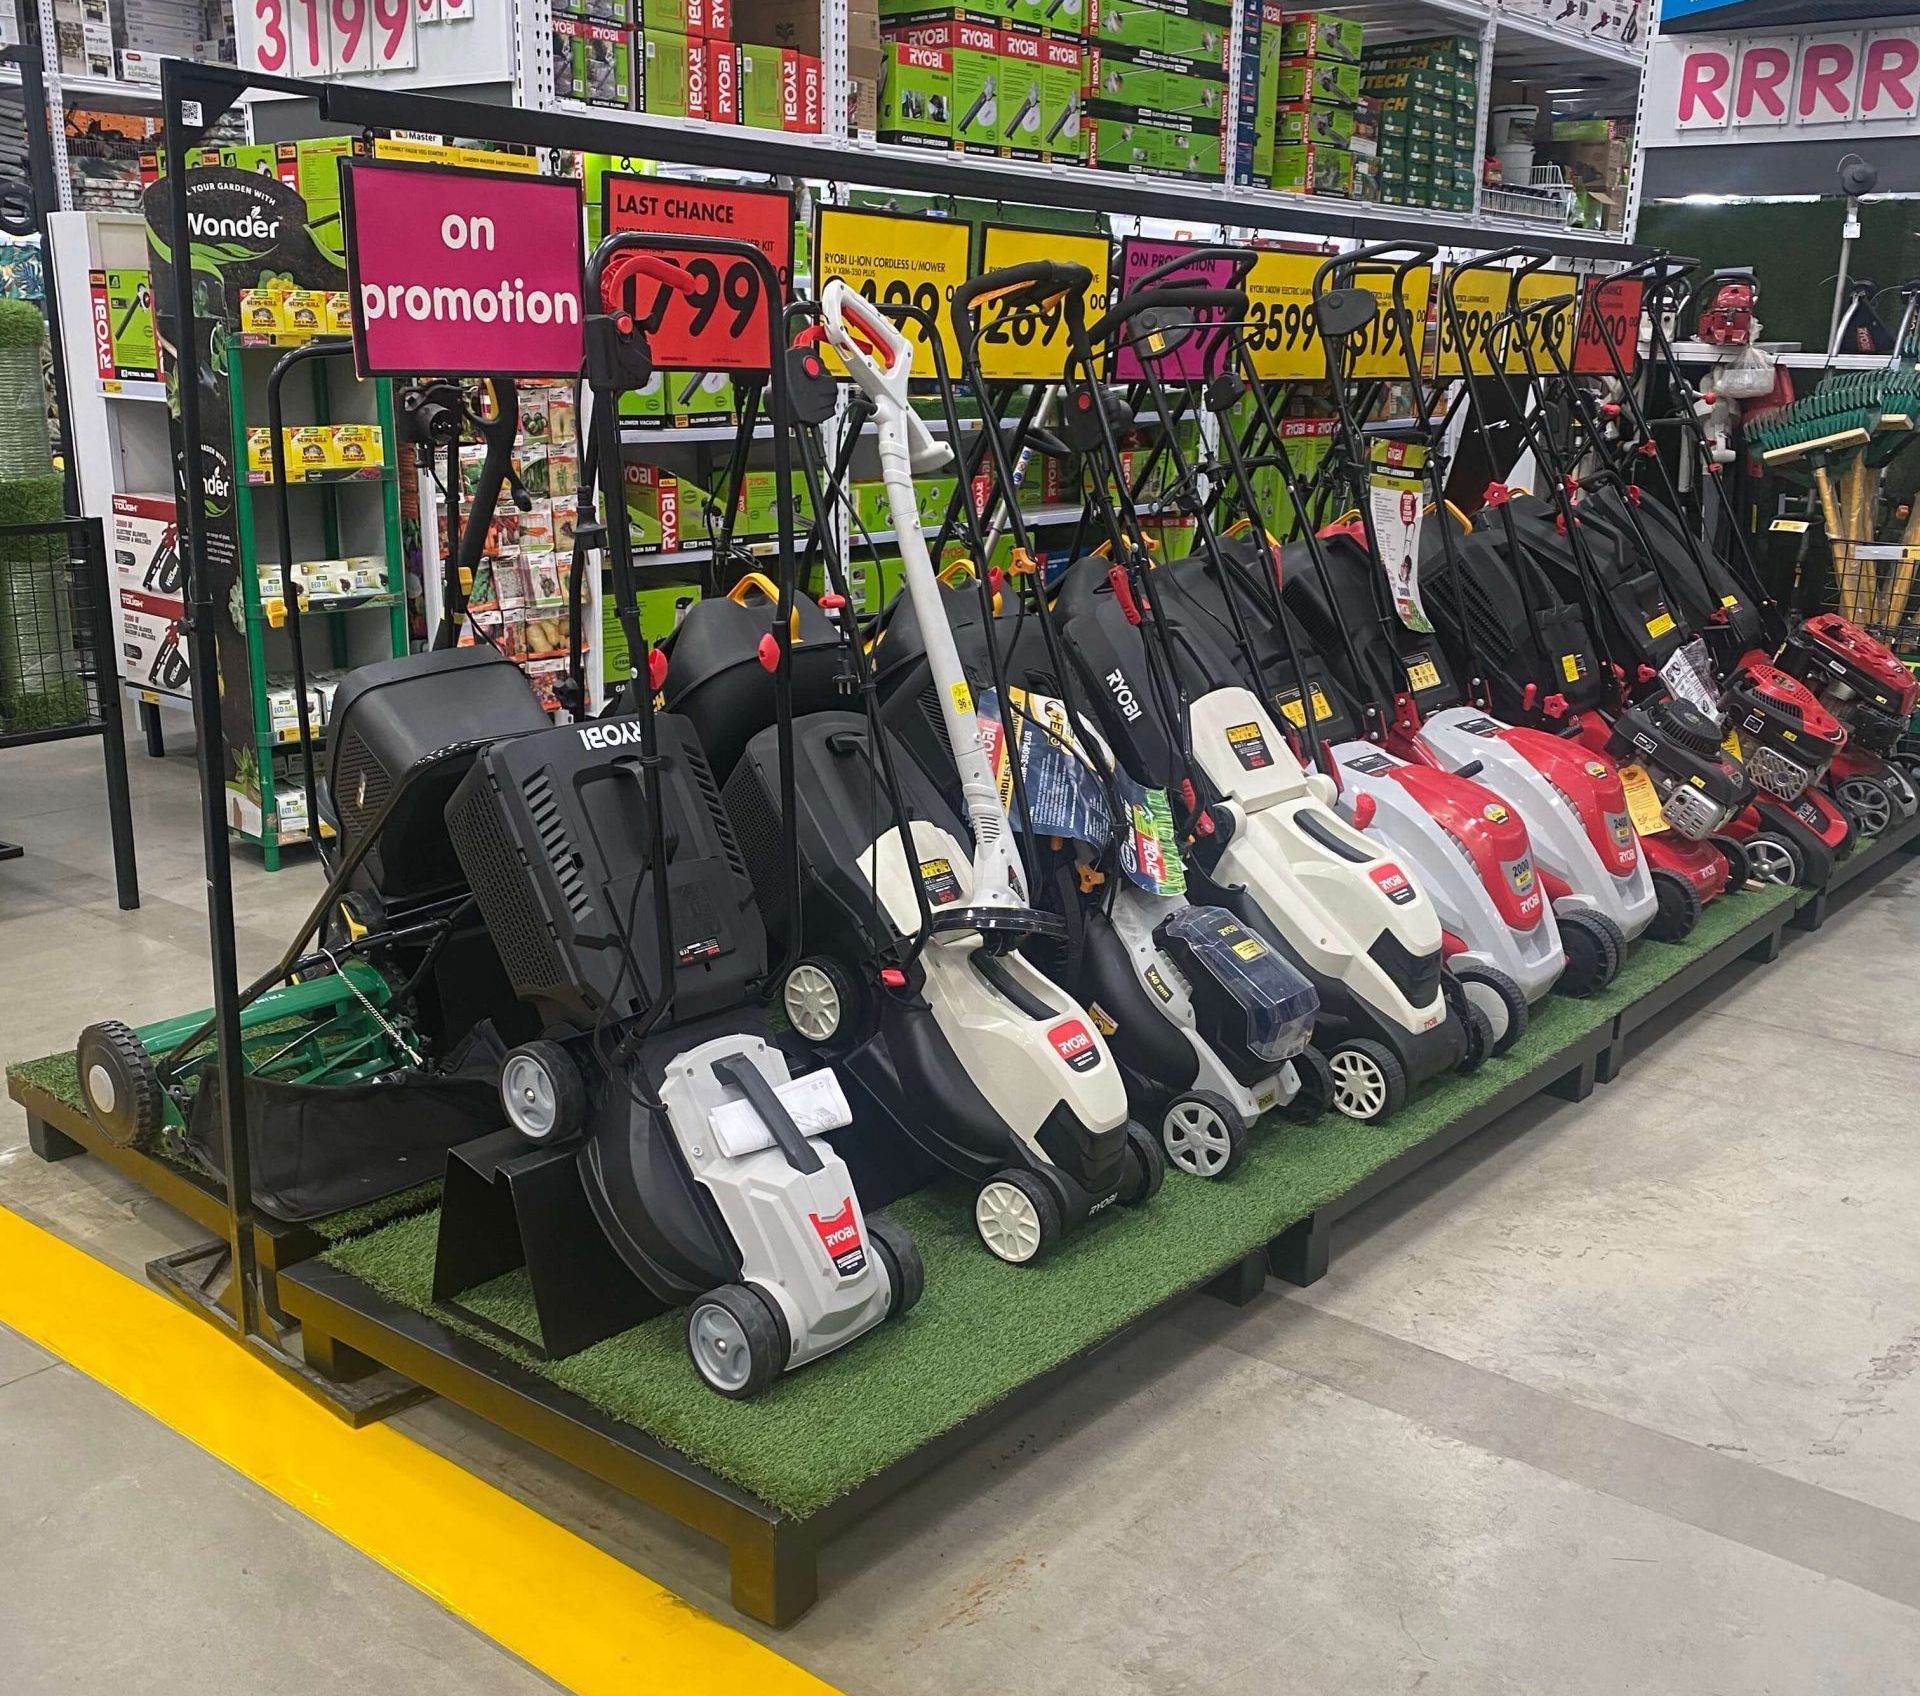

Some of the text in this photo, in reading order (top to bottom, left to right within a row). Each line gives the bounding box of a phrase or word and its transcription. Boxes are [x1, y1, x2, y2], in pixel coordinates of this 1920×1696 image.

[1262, 4, 1281, 23] YOBI
[592, 27, 620, 41] RYOBI
[908, 28, 949, 46] RYOBI
[961, 28, 995, 49] RYOBI
[1008, 37, 1040, 57] RYOBI
[1049, 46, 1079, 65] RYOBI
[910, 49, 944, 69] RYOBI
[688, 47, 702, 112] RYOBI
[718, 54, 731, 114] RYOBI
[784, 61, 798, 121] RYOBI
[805, 68, 818, 125] RYOBI
[408, 131, 437, 142] Master
[902, 135, 922, 143] GARDEN
[1307, 152, 1315, 189] RYOBI
[191, 182, 276, 206] YOUR GARDEN WITH
[617, 194, 734, 223] LAST CHANCE
[441, 214, 495, 251] on
[762, 240, 775, 252] KIT
[824, 253, 945, 273] RYOBI LI-ION CORDLESS L/MOWER
[1131, 252, 1216, 273] ON PROTION
[361, 278, 579, 331] promotion
[1090, 294, 1106, 310] 00
[1249, 302, 1317, 352] 3599
[1416, 310, 1426, 323] 00
[94, 298, 111, 370] RYOBI
[624, 465, 652, 485] YOBI
[203, 474, 229, 498] nder
[114, 502, 138, 512] TOUGH
[662, 493, 676, 550] RYOBI
[263, 585, 273, 593] ECO
[311, 581, 321, 589] ECO
[121, 596, 144, 608] TOUGH
[1106, 668, 1143, 722] RYOBI
[274, 706, 284, 714] ECO
[577, 721, 641, 750] RYOBI
[282, 806, 291, 815] ECO
[1143, 838, 1160, 880] RYOBI
[1618, 848, 1636, 864] RYOBI
[1512, 858, 1530, 876] 2000
[1379, 874, 1405, 892] RYOBI
[1519, 893, 1540, 914] RYOBI
[1147, 970, 1170, 999] 340 mm
[1058, 1032, 1089, 1055] RYOBI
[1088, 1191, 1118, 1216] RYOBI
[825, 1224, 856, 1247] RYOBI
